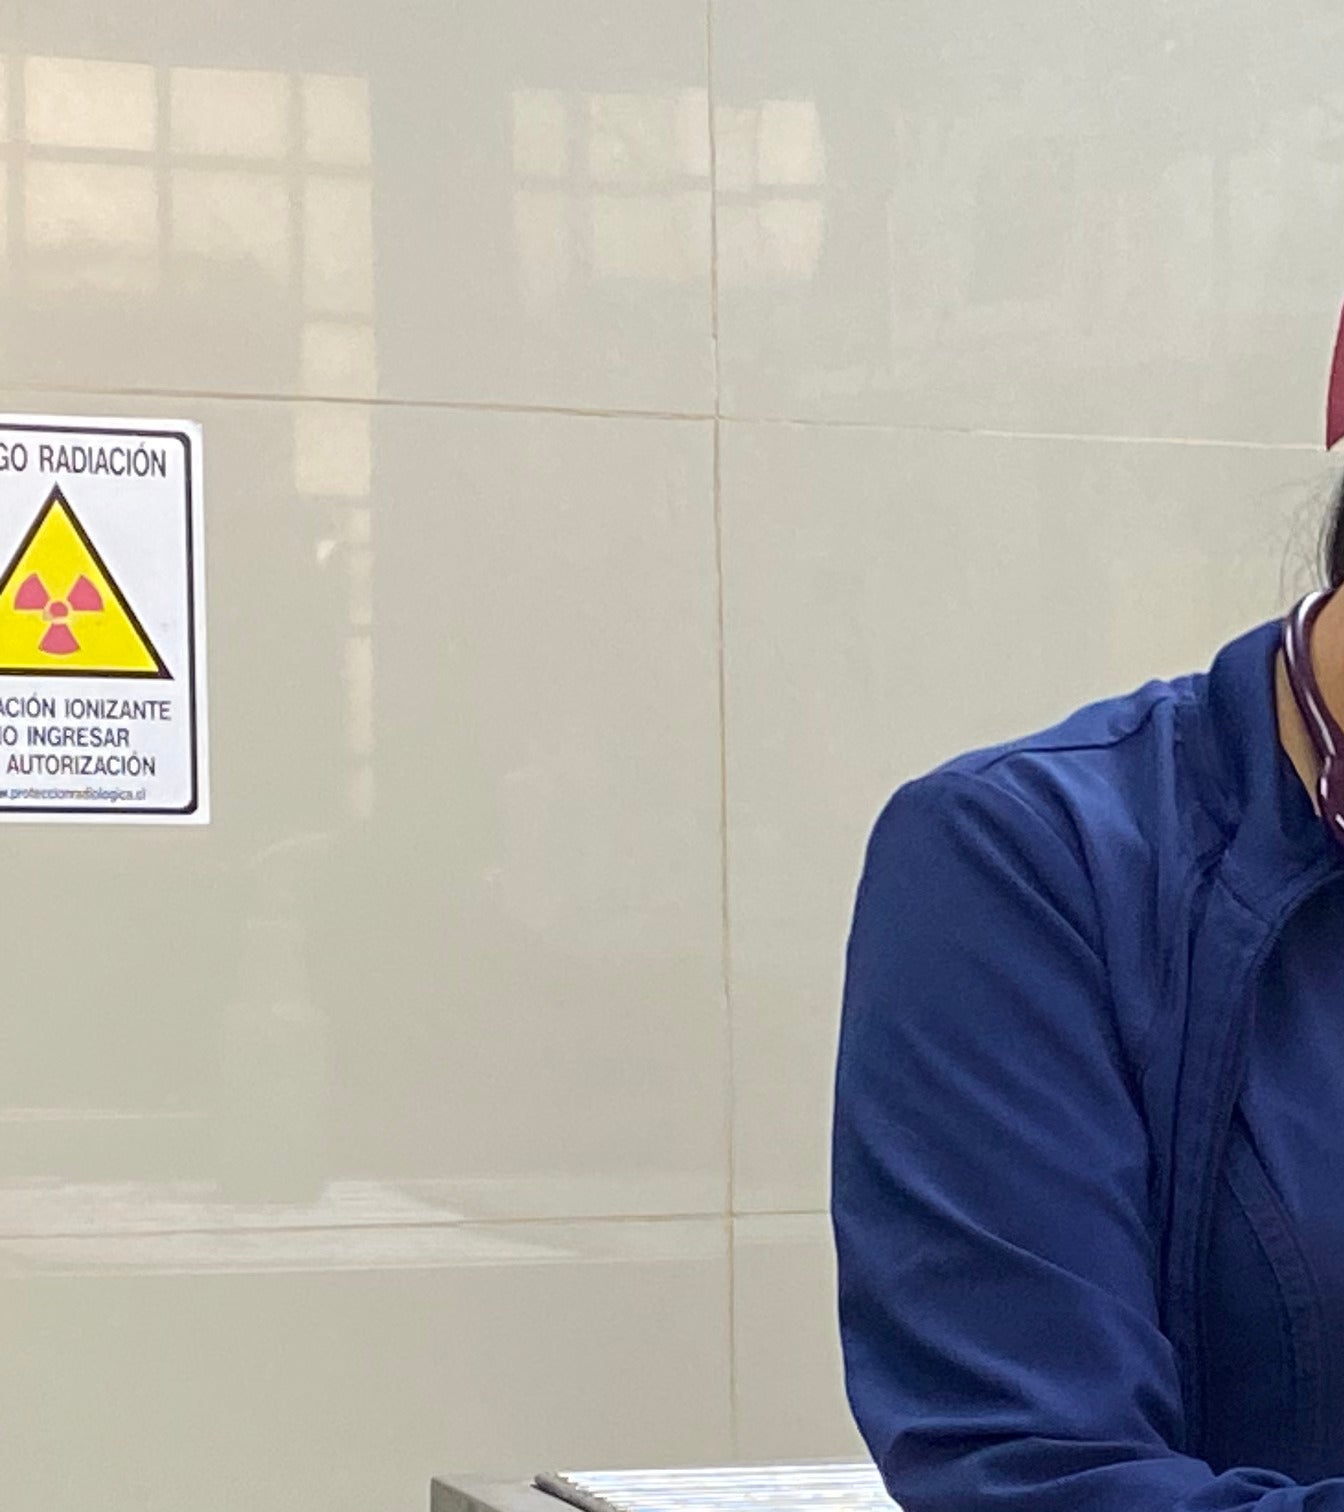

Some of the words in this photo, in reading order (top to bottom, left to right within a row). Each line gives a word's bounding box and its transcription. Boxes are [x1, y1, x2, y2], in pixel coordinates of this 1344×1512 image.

[38, 441, 167, 478] RADIACIÓN
[0, 692, 56, 719] CIÓN
[65, 698, 172, 721] IONIZANTE
[0, 725, 18, 746] O
[27, 726, 130, 748] INGRESAR
[6, 751, 156, 777] AUTORIZACIÓN
